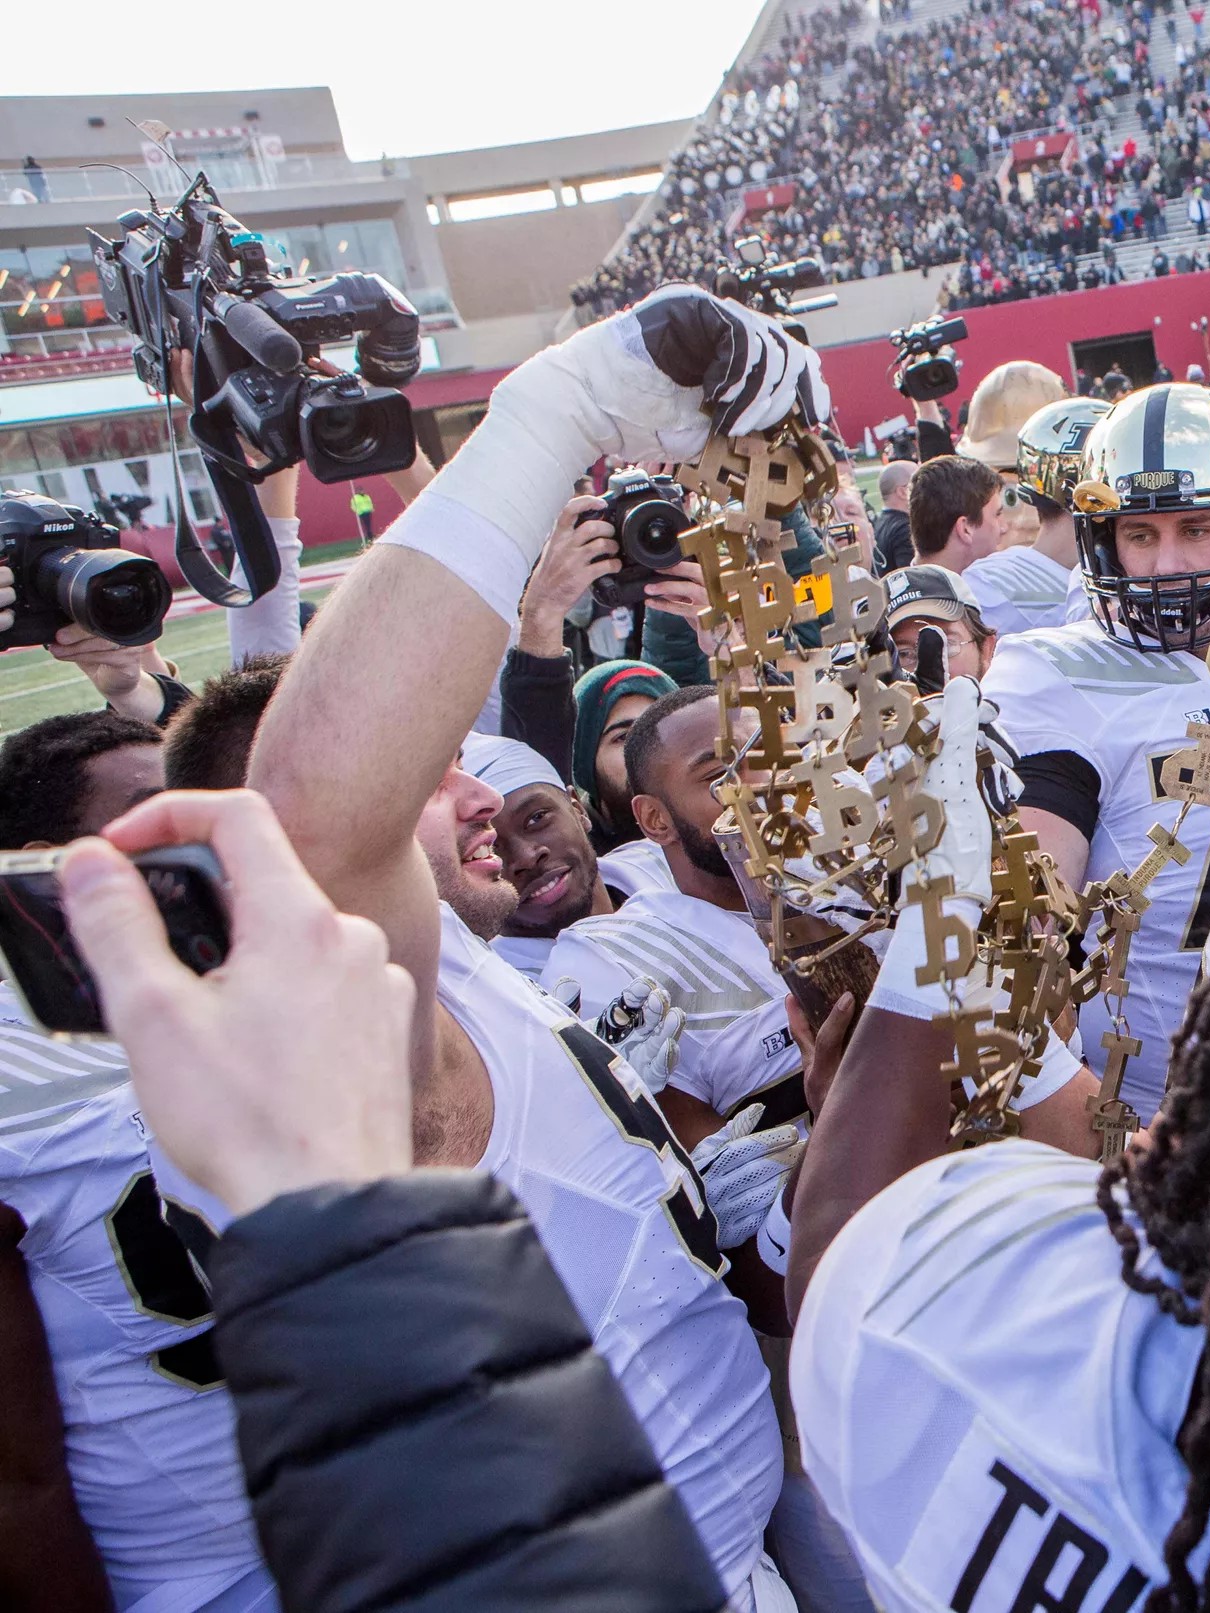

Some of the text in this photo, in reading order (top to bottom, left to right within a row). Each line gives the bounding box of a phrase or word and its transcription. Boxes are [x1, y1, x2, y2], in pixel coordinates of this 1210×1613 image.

[624, 481, 651, 494] Nikon
[1133, 470, 1176, 490] PURDUE
[43, 522, 75, 534] Nikon
[886, 589, 923, 613] PURDUE
[1160, 608, 1184, 616] ddell.
[1131, 857, 1156, 885] INDIANA
[1139, 863, 1162, 889] PURDUE
[762, 1026, 795, 1059] BI
[950, 1459, 1151, 1613] TR
